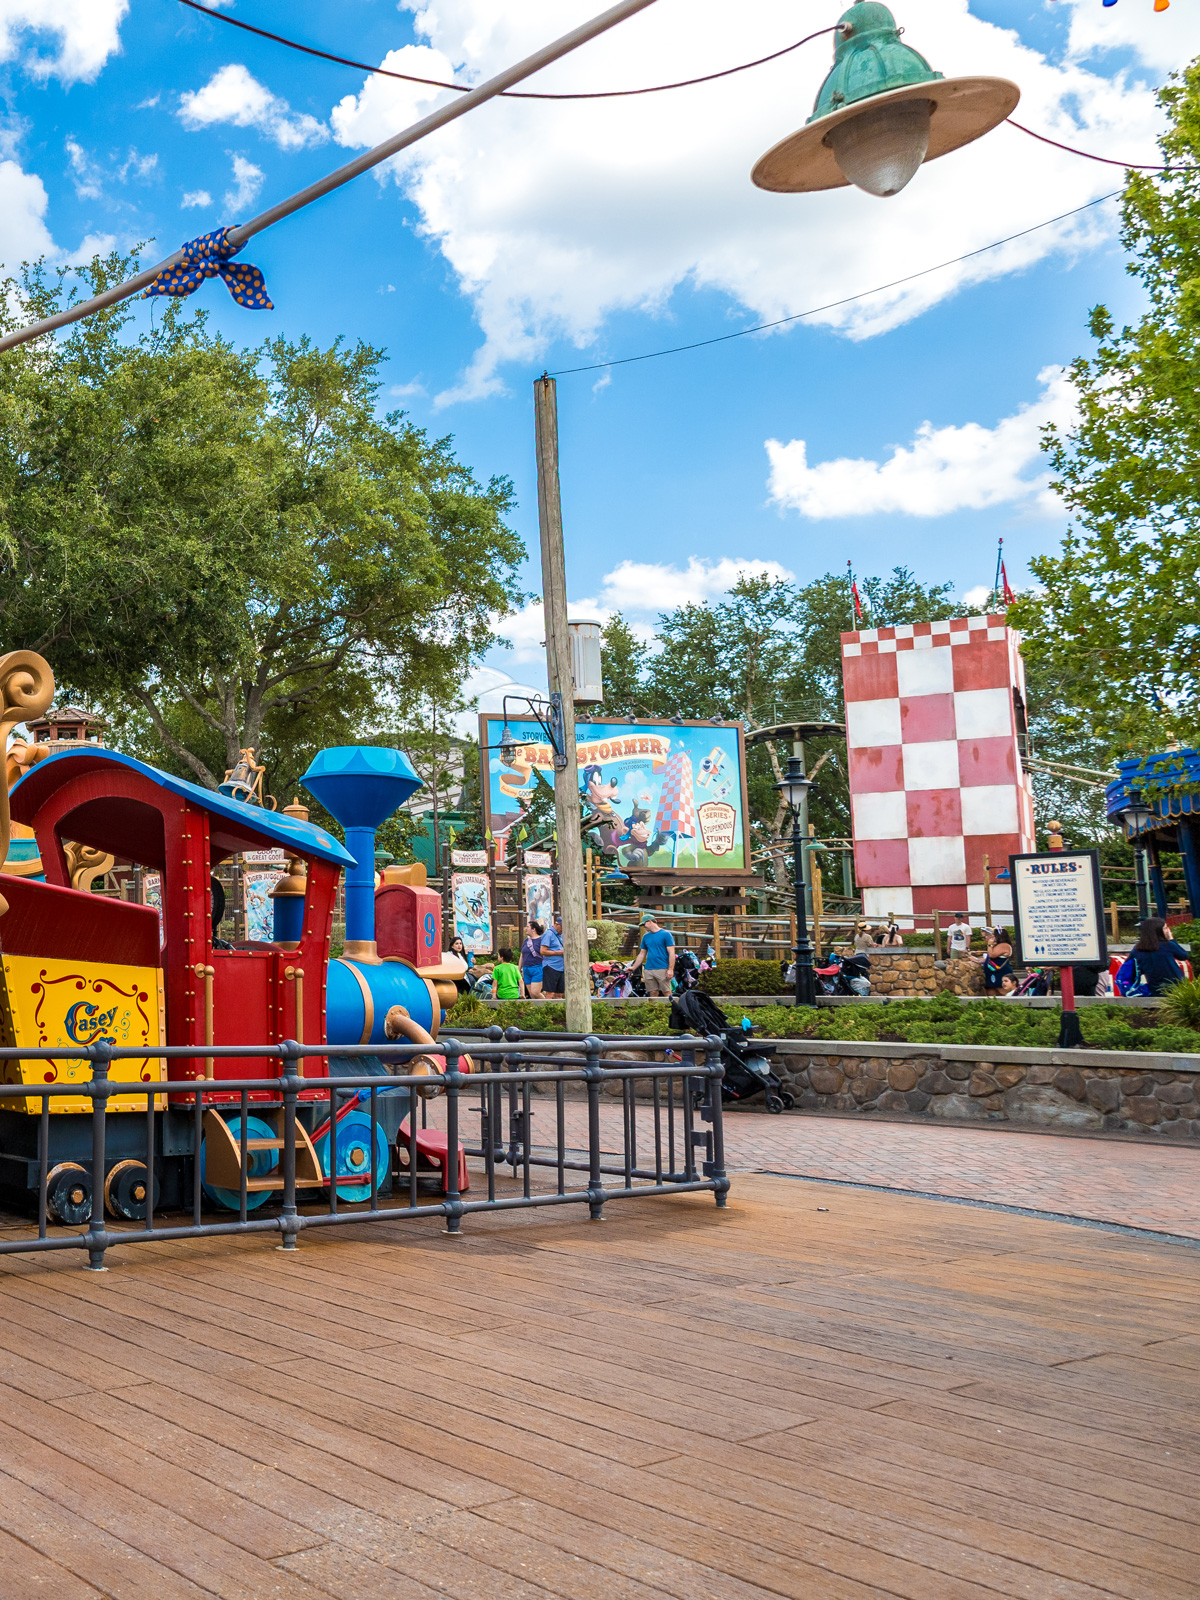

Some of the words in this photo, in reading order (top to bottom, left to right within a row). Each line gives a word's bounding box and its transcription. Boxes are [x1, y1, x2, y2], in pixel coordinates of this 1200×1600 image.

[524, 738, 663, 764] BASTORMER
[704, 821, 732, 834] STUPENDOUS
[706, 836, 730, 844] STUNTS
[1030, 862, 1077, 874] RULES
[424, 912, 436, 948] 9
[64, 1001, 118, 1044] Casey
